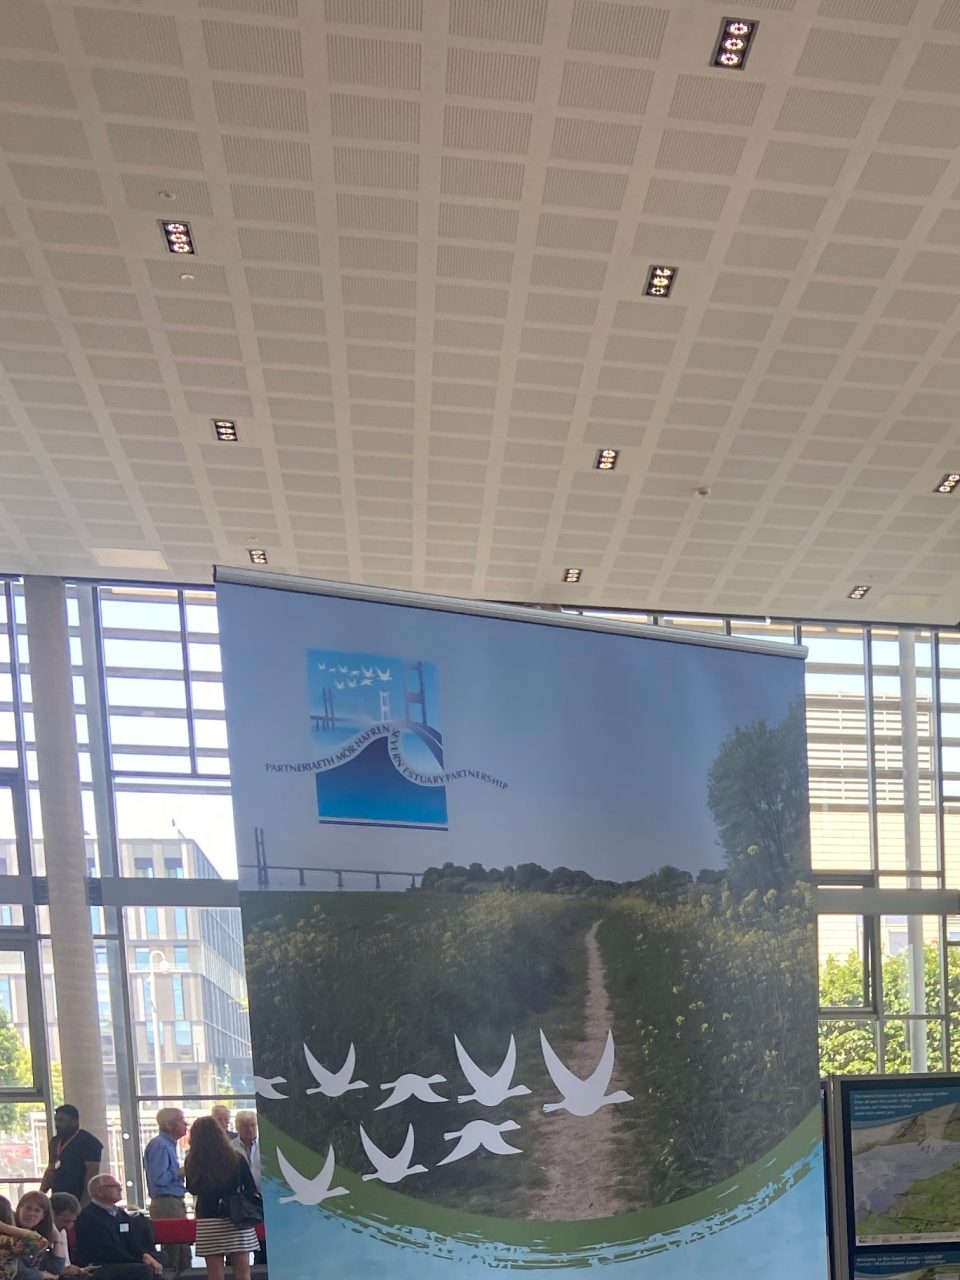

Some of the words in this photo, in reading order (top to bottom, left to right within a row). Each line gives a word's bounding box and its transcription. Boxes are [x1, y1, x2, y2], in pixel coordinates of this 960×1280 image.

[265, 756, 336, 773] PARTNERIAETH
[354, 724, 391, 749] HAFREN
[402, 765, 444, 785] ESTUARY
[445, 768, 509, 790] PARTNERSHIP
